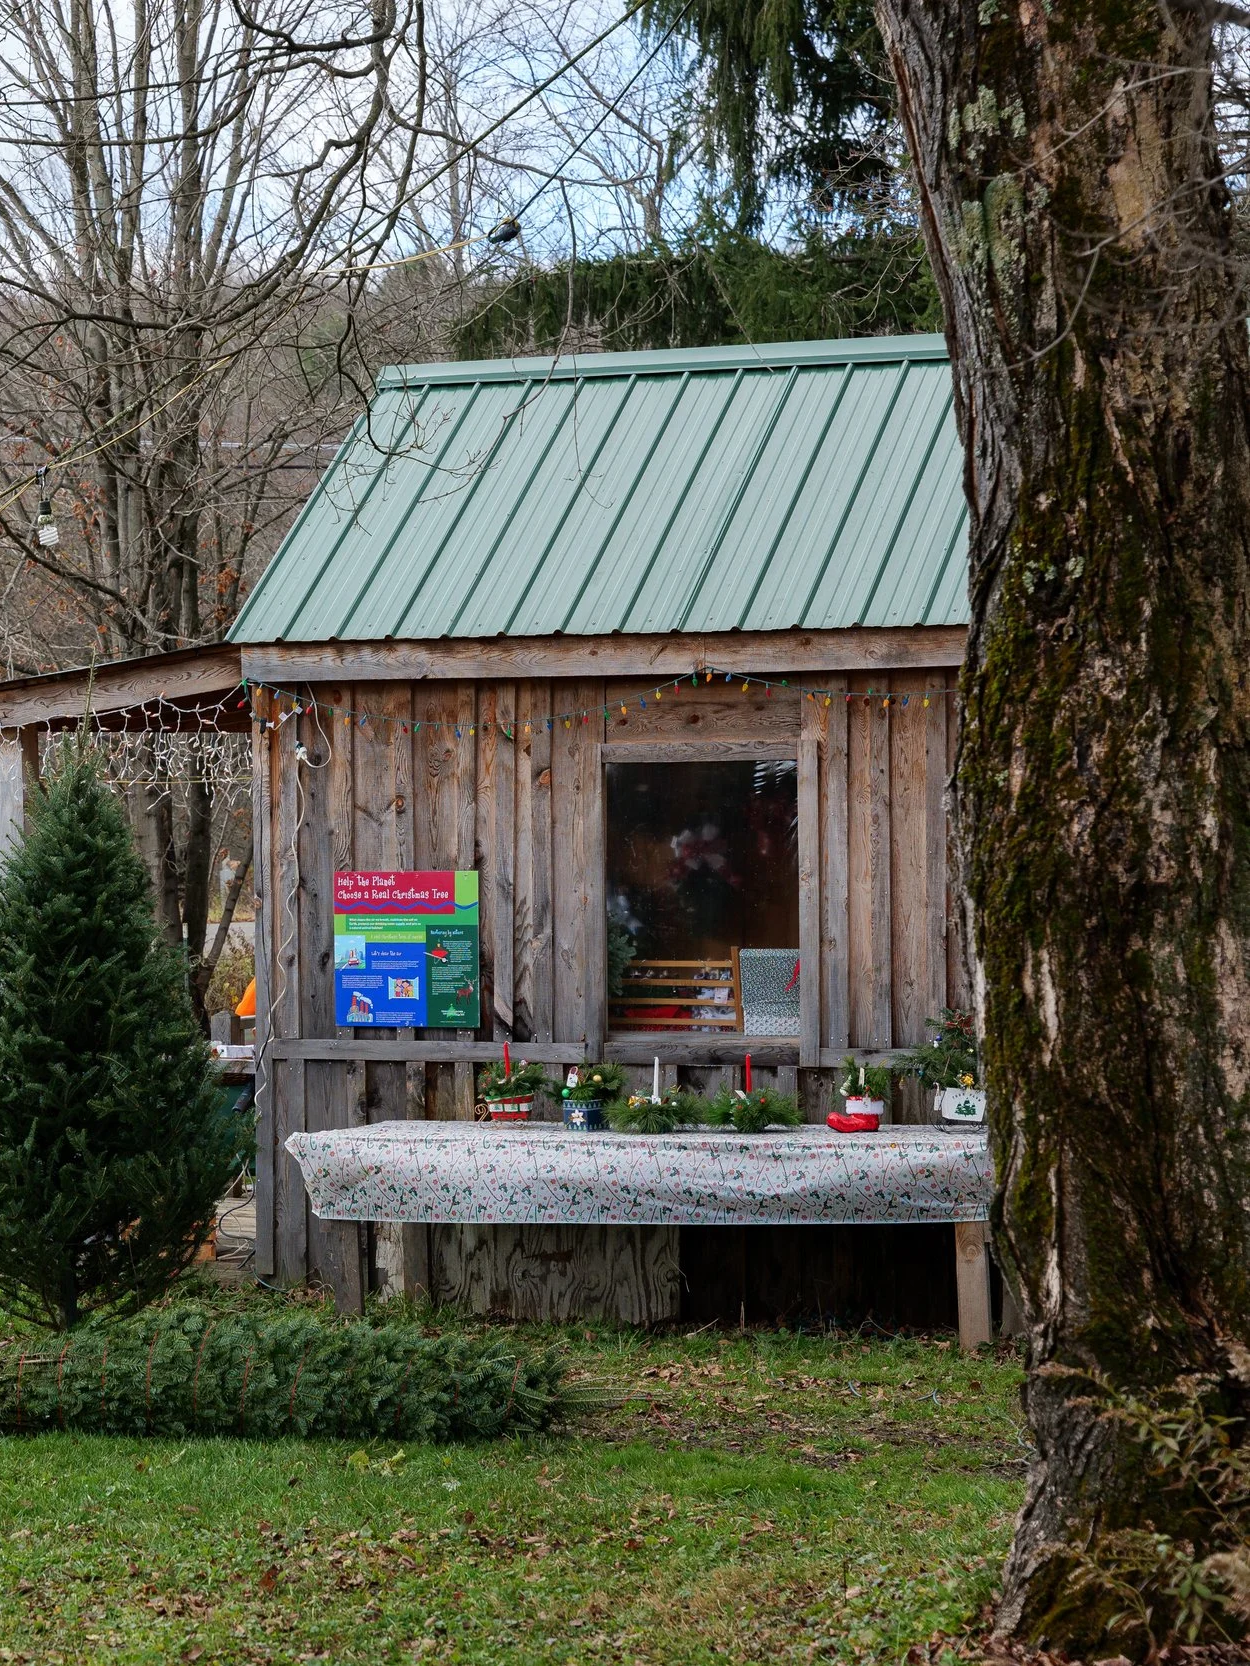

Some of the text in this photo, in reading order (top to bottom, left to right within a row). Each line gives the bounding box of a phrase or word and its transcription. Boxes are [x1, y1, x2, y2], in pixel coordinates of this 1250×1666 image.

[337, 874, 396, 890] Help the Planet
[337, 889, 362, 900] Choose
[372, 889, 390, 900] Real
[392, 887, 429, 900] Christmas
[432, 888, 449, 899] Tree
